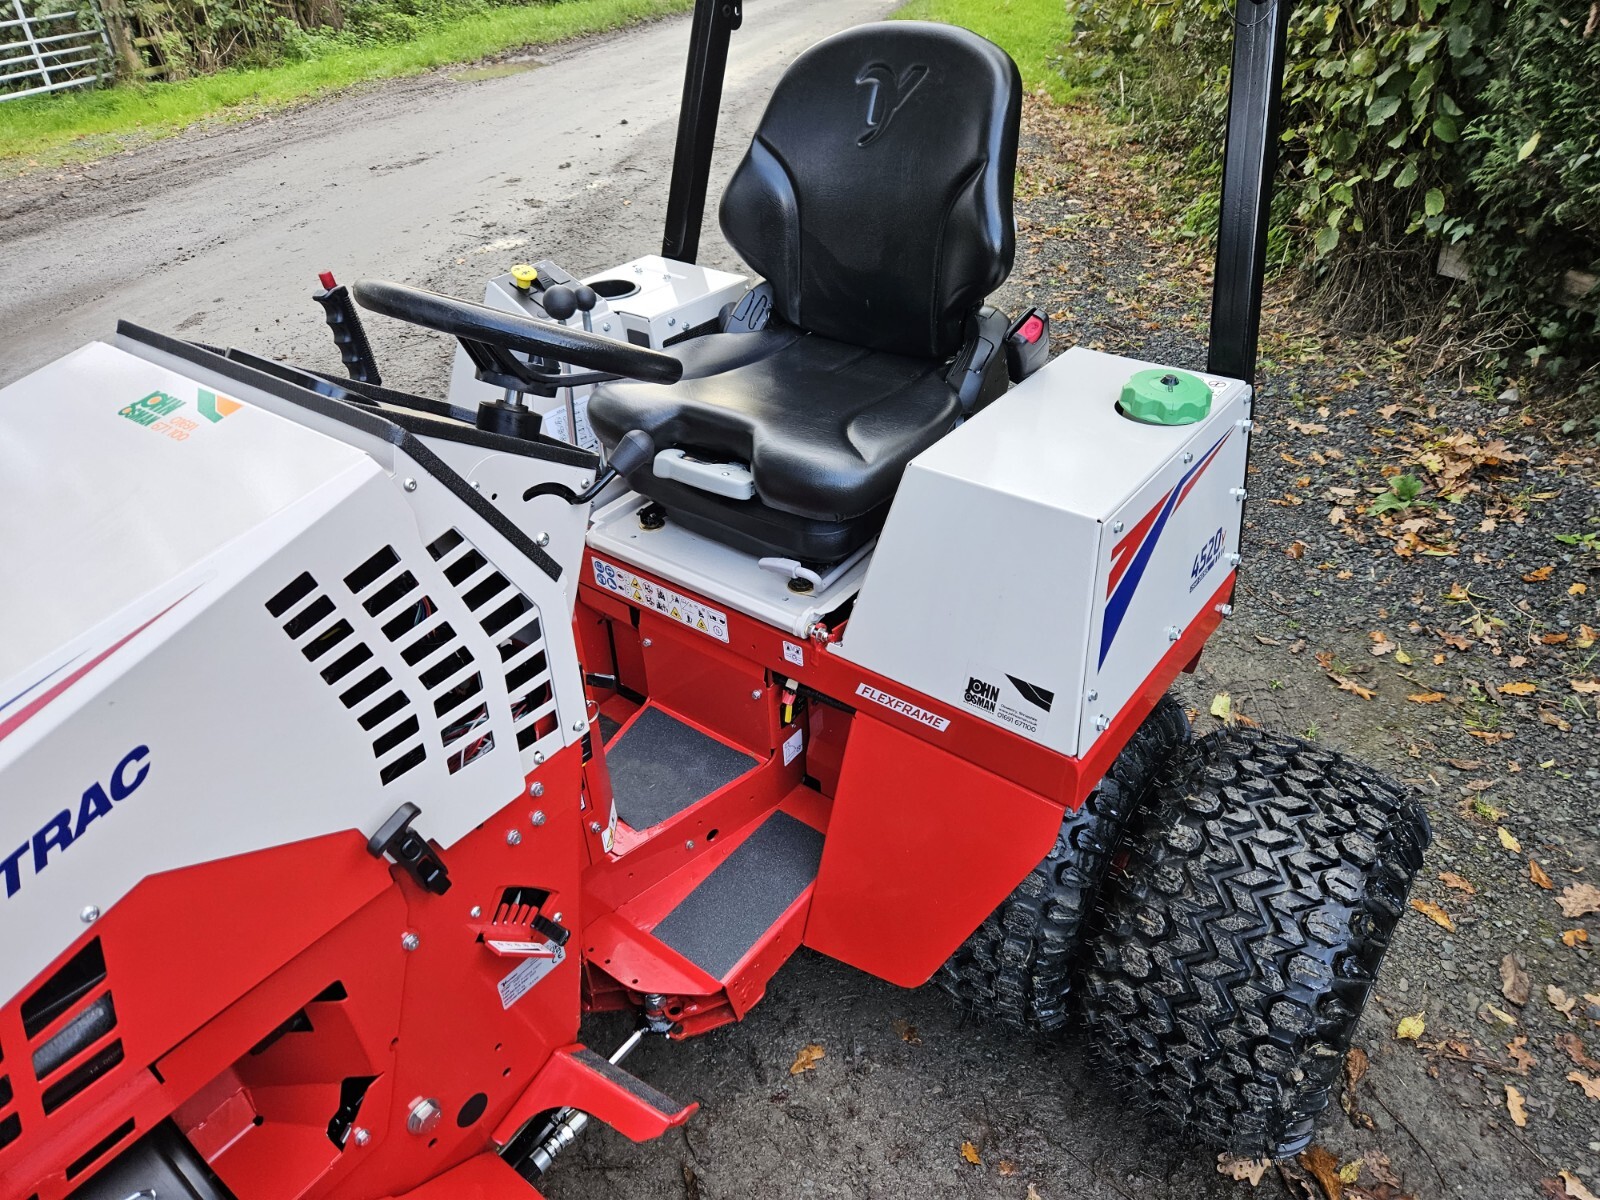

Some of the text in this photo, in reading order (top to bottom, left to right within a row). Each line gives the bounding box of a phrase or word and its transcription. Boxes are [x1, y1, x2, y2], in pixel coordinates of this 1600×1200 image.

[964, 692, 996, 713] OSMAN
[965, 676, 1000, 702] JOHN
[861, 686, 944, 728] FLEXFRAME
[0, 744, 151, 899] TRAC
